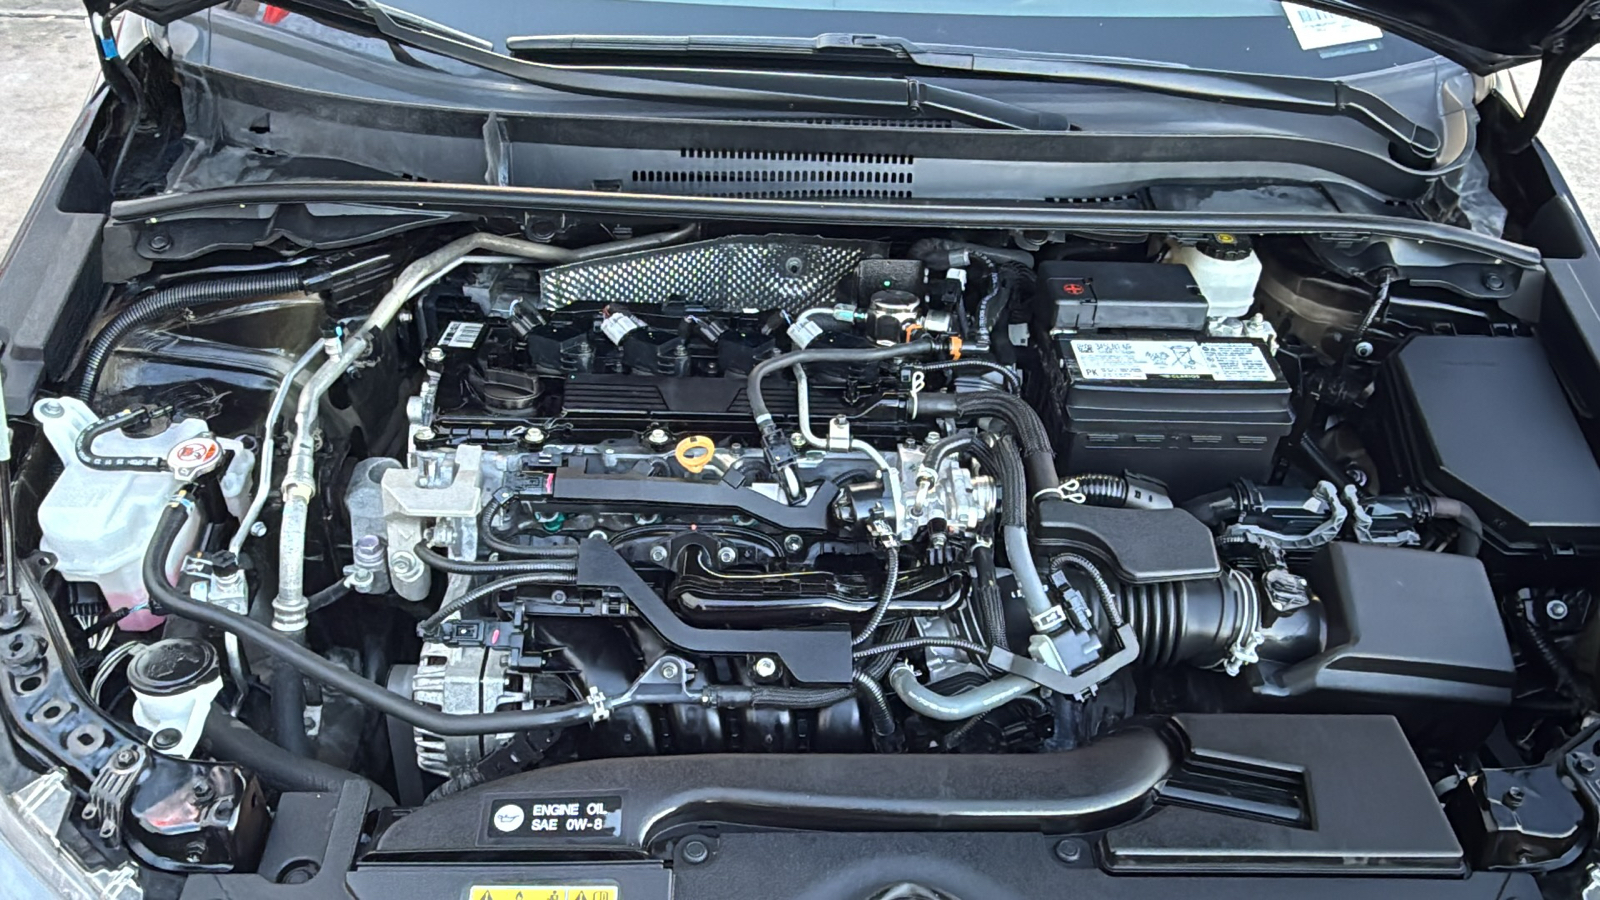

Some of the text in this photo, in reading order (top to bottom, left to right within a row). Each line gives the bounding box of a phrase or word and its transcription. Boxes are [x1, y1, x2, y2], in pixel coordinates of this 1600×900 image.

[532, 802, 608, 817] ENGINE OIL
[531, 818, 603, 831] SAE 0W-8
